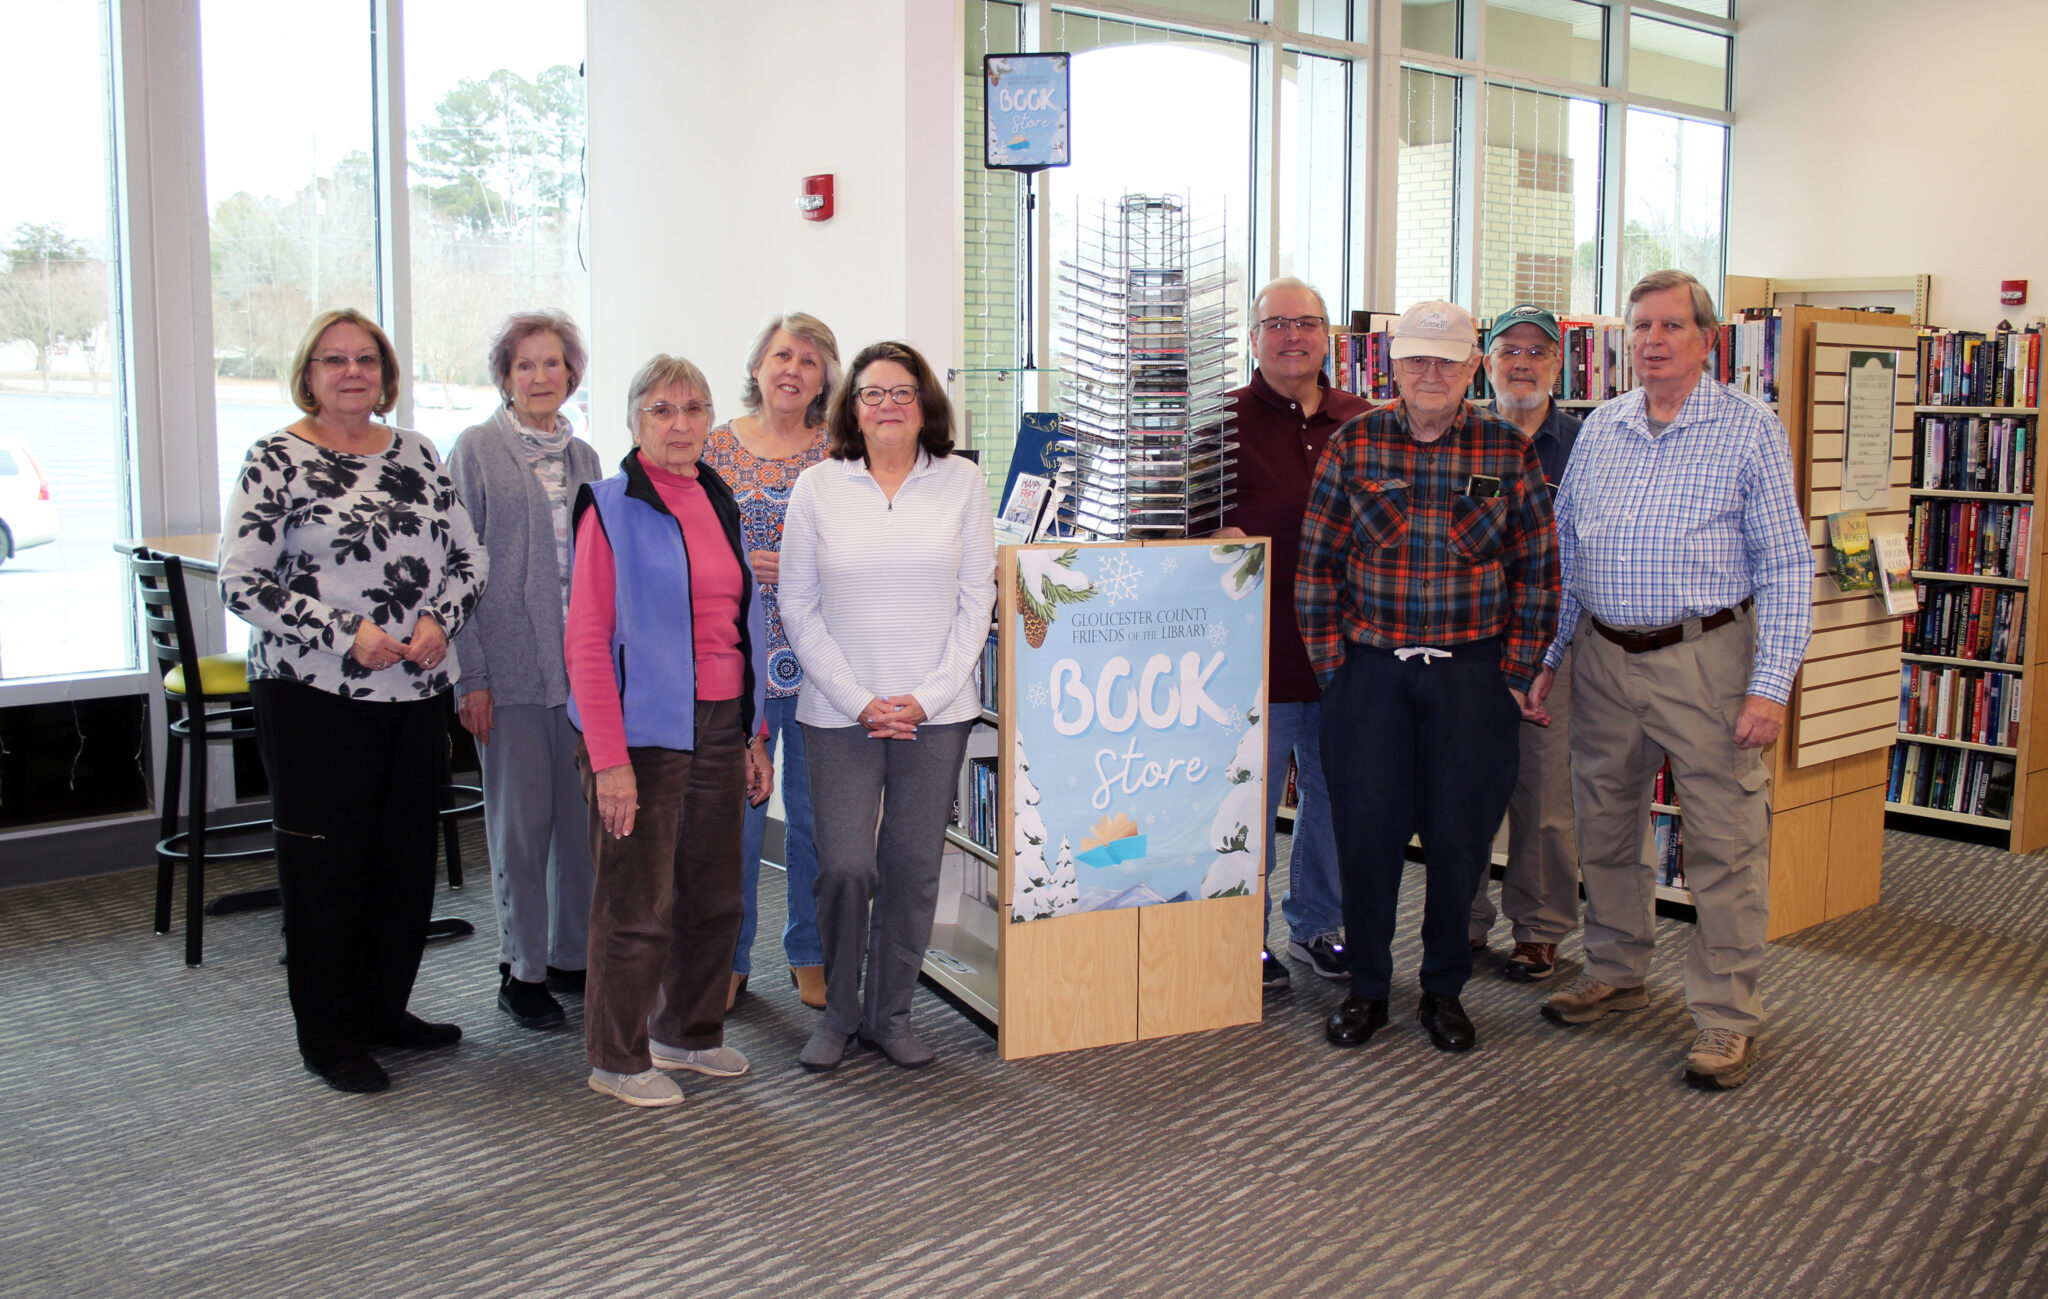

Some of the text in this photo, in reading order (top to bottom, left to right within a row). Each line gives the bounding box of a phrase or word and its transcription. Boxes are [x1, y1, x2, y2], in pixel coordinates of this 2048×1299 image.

[1000, 88, 1057, 111] BOOK
[1011, 112, 1049, 133] Store
[1021, 478, 1043, 490] HAPPY
[1847, 520, 1865, 529] NORA
[1848, 554, 1871, 563] IDENTITY
[1071, 608, 1209, 627] GLOUCESTER COUNTY
[1072, 624, 1209, 644] FRIENDS OF THE LIBRARY
[1050, 650, 1231, 736] BOOK
[1091, 736, 1209, 810] Store
